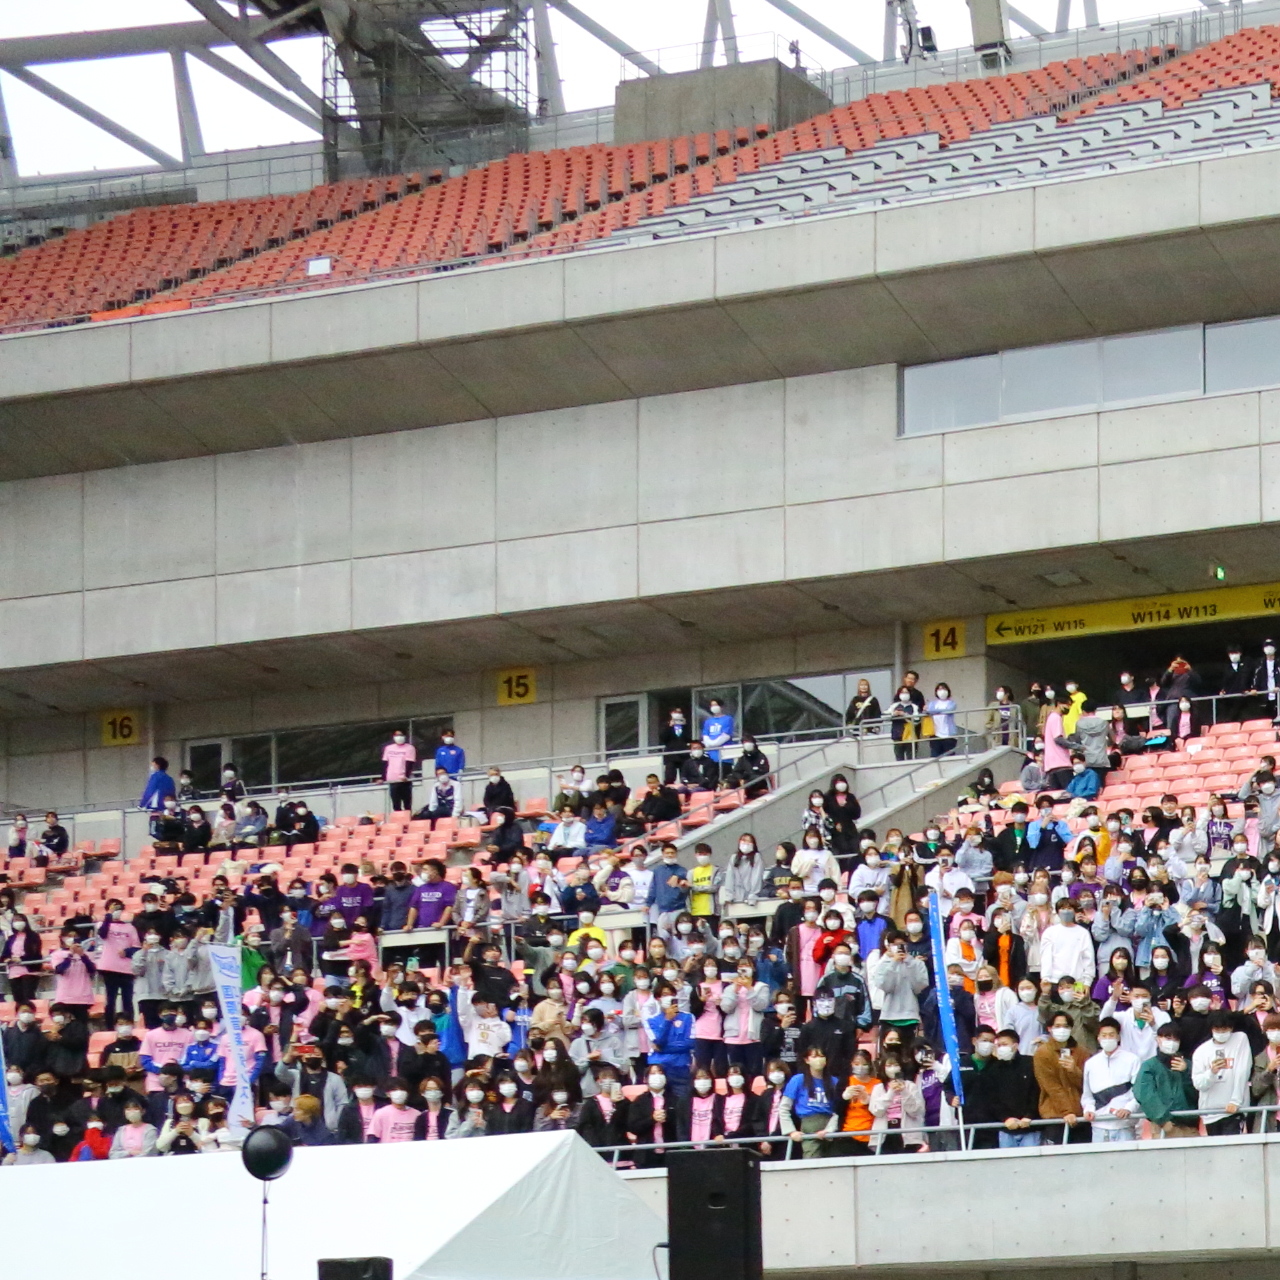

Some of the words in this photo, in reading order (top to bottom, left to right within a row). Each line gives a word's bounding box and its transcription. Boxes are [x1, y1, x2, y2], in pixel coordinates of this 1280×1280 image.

[1132, 610, 1170, 623] W114
[1178, 604, 1217, 619] W113
[930, 627, 958, 653] 14
[1014, 624, 1045, 636] W121
[504, 676, 528, 697] 15
[108, 717, 132, 739] 16
